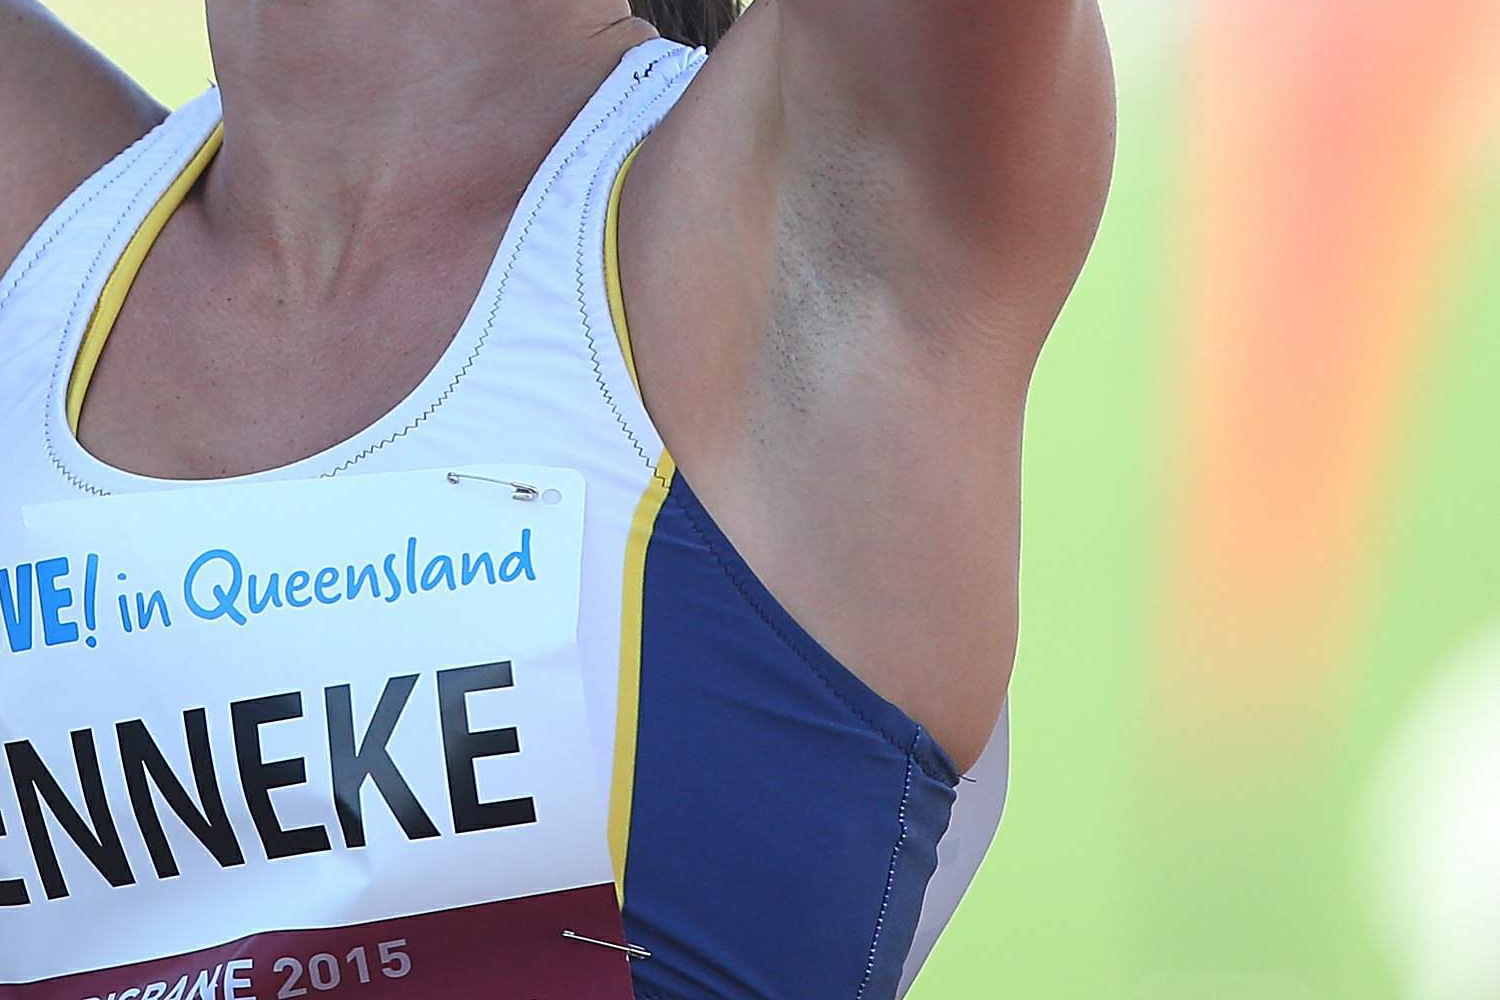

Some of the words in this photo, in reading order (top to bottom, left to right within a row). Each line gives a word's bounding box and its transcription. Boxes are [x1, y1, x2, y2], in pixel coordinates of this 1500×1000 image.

[117, 573, 171, 632] in
[184, 529, 536, 625] Queensland
[273, 939, 411, 999] 2015
